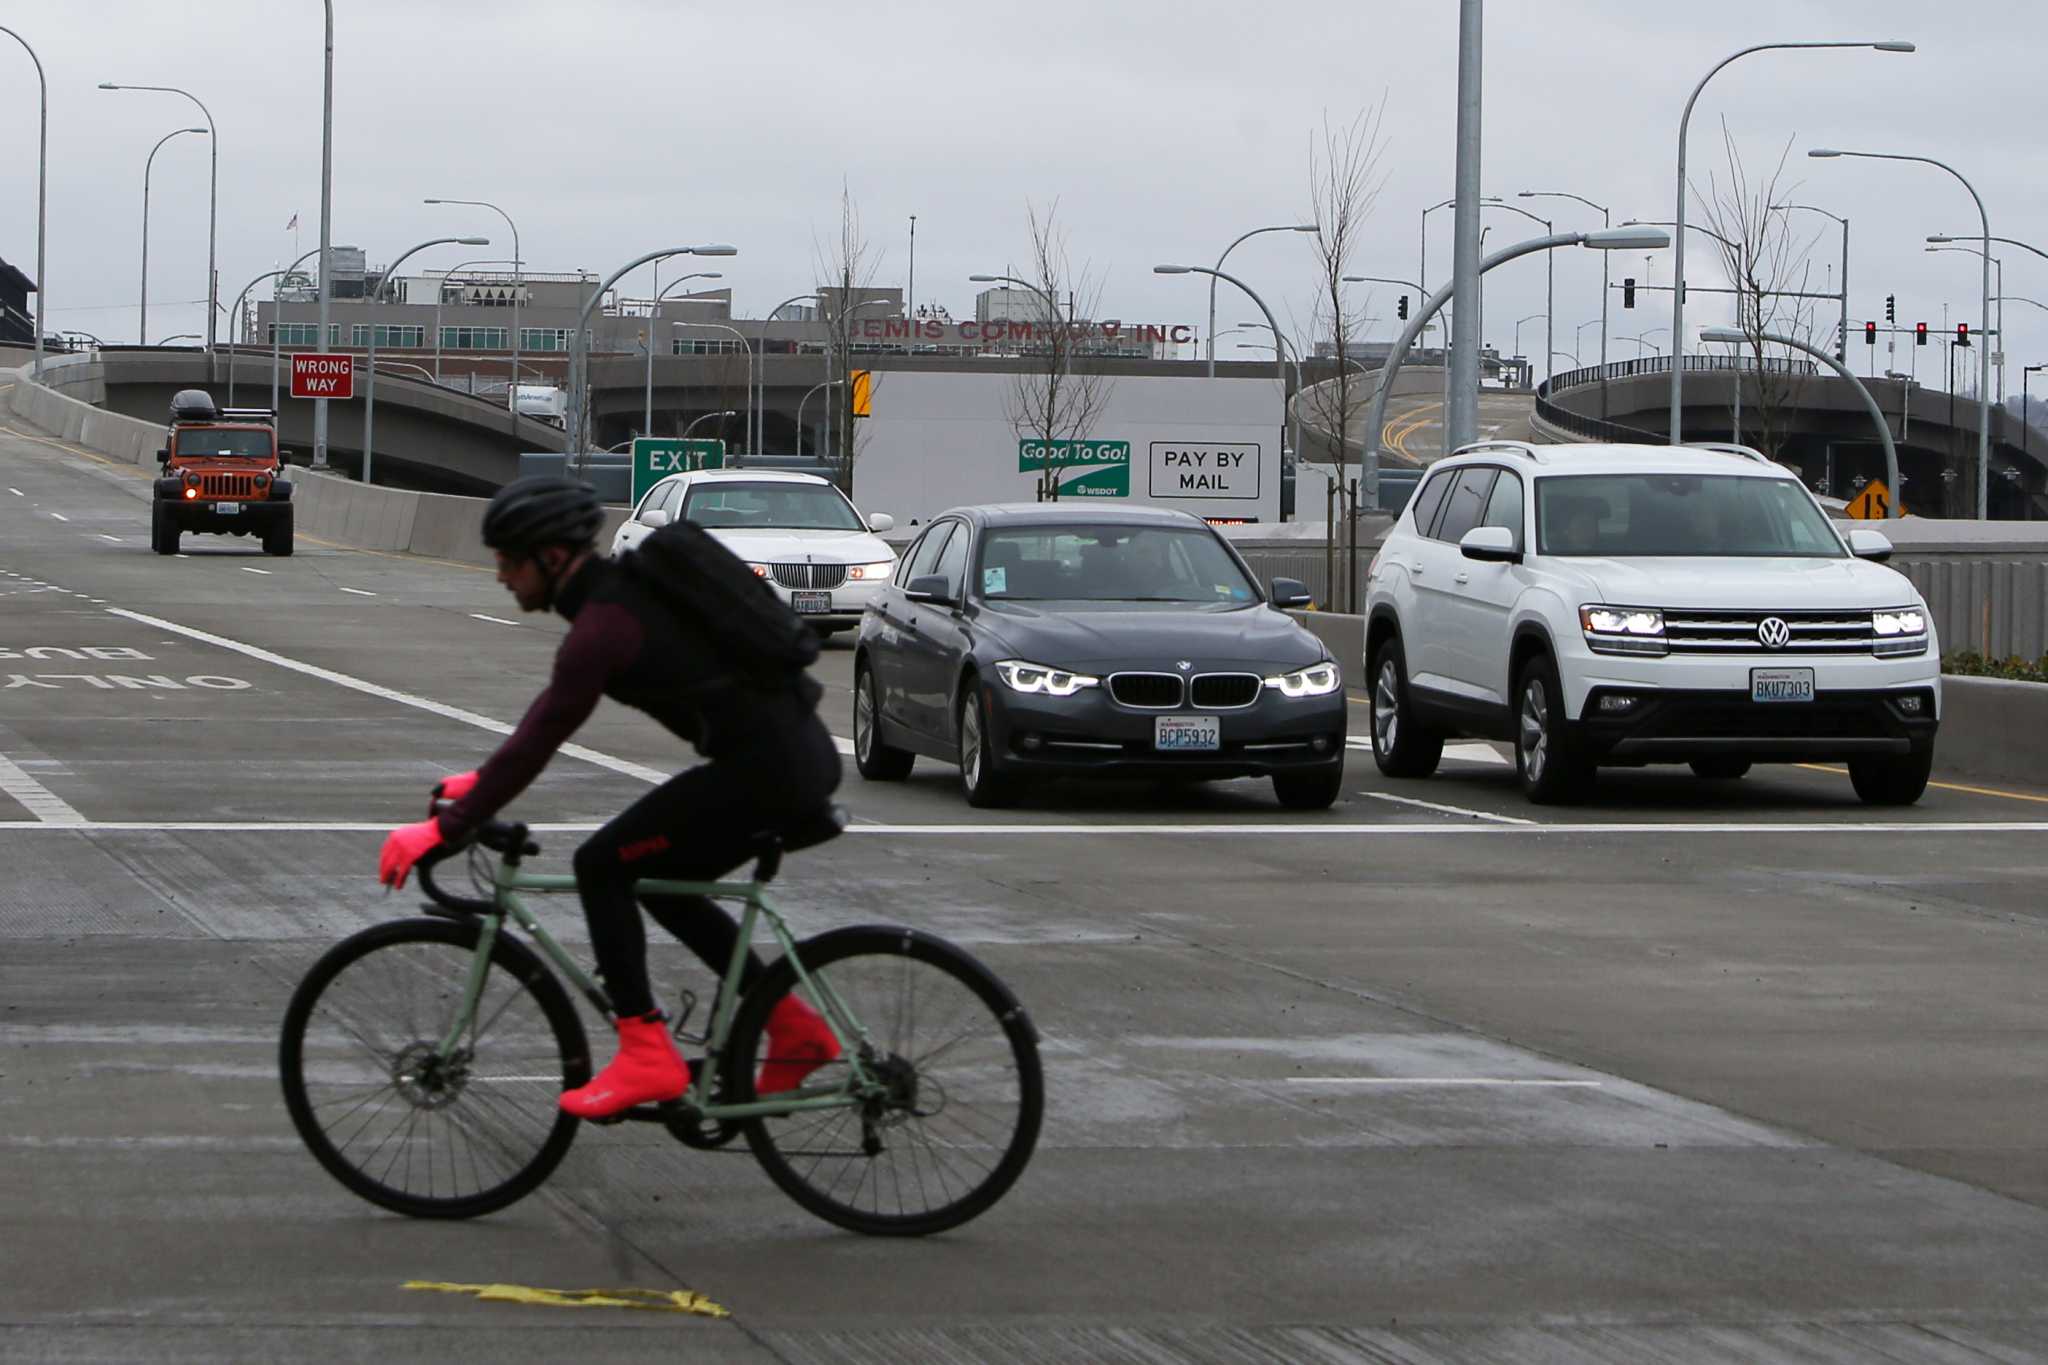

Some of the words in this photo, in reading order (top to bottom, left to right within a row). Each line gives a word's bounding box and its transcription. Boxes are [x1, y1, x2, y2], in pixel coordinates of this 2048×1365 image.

[959, 319, 1122, 342] COMY
[296, 360, 349, 374] WRONG
[306, 378, 337, 392] WAY
[1021, 443, 1072, 459] Good
[1073, 444, 1093, 460] To
[1096, 444, 1128, 460] Go!
[1165, 451, 1207, 467] PAY
[1217, 452, 1245, 468] BY
[649, 450, 708, 471] EXIT
[1180, 474, 1229, 490] MAIL
[1087, 487, 1118, 496] WSDOT
[4, 674, 253, 690] ONLY
[1756, 680, 1811, 698] BKU7303
[1159, 728, 1216, 745] BCP5932
